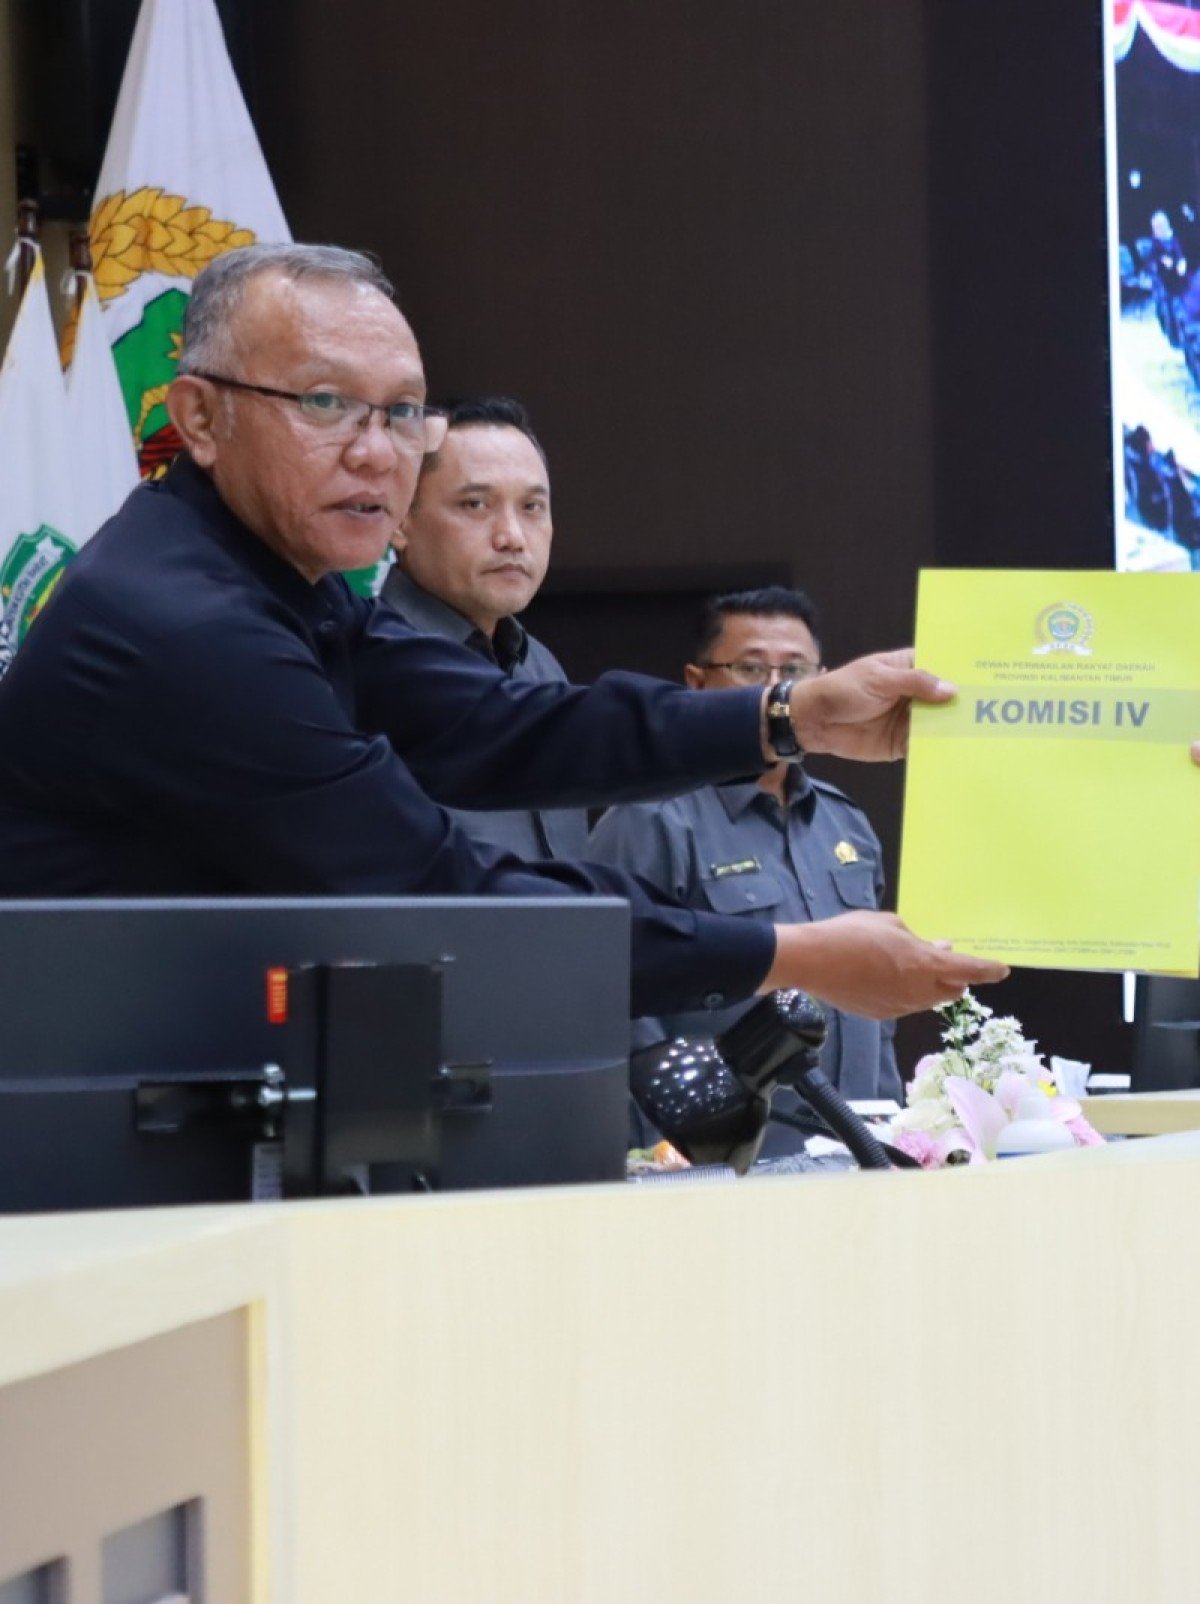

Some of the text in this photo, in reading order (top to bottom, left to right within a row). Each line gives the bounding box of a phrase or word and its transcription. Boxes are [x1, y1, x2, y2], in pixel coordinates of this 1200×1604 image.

[975, 661, 1010, 669] DEWAN
[975, 699, 1150, 727] KOMISI IV
